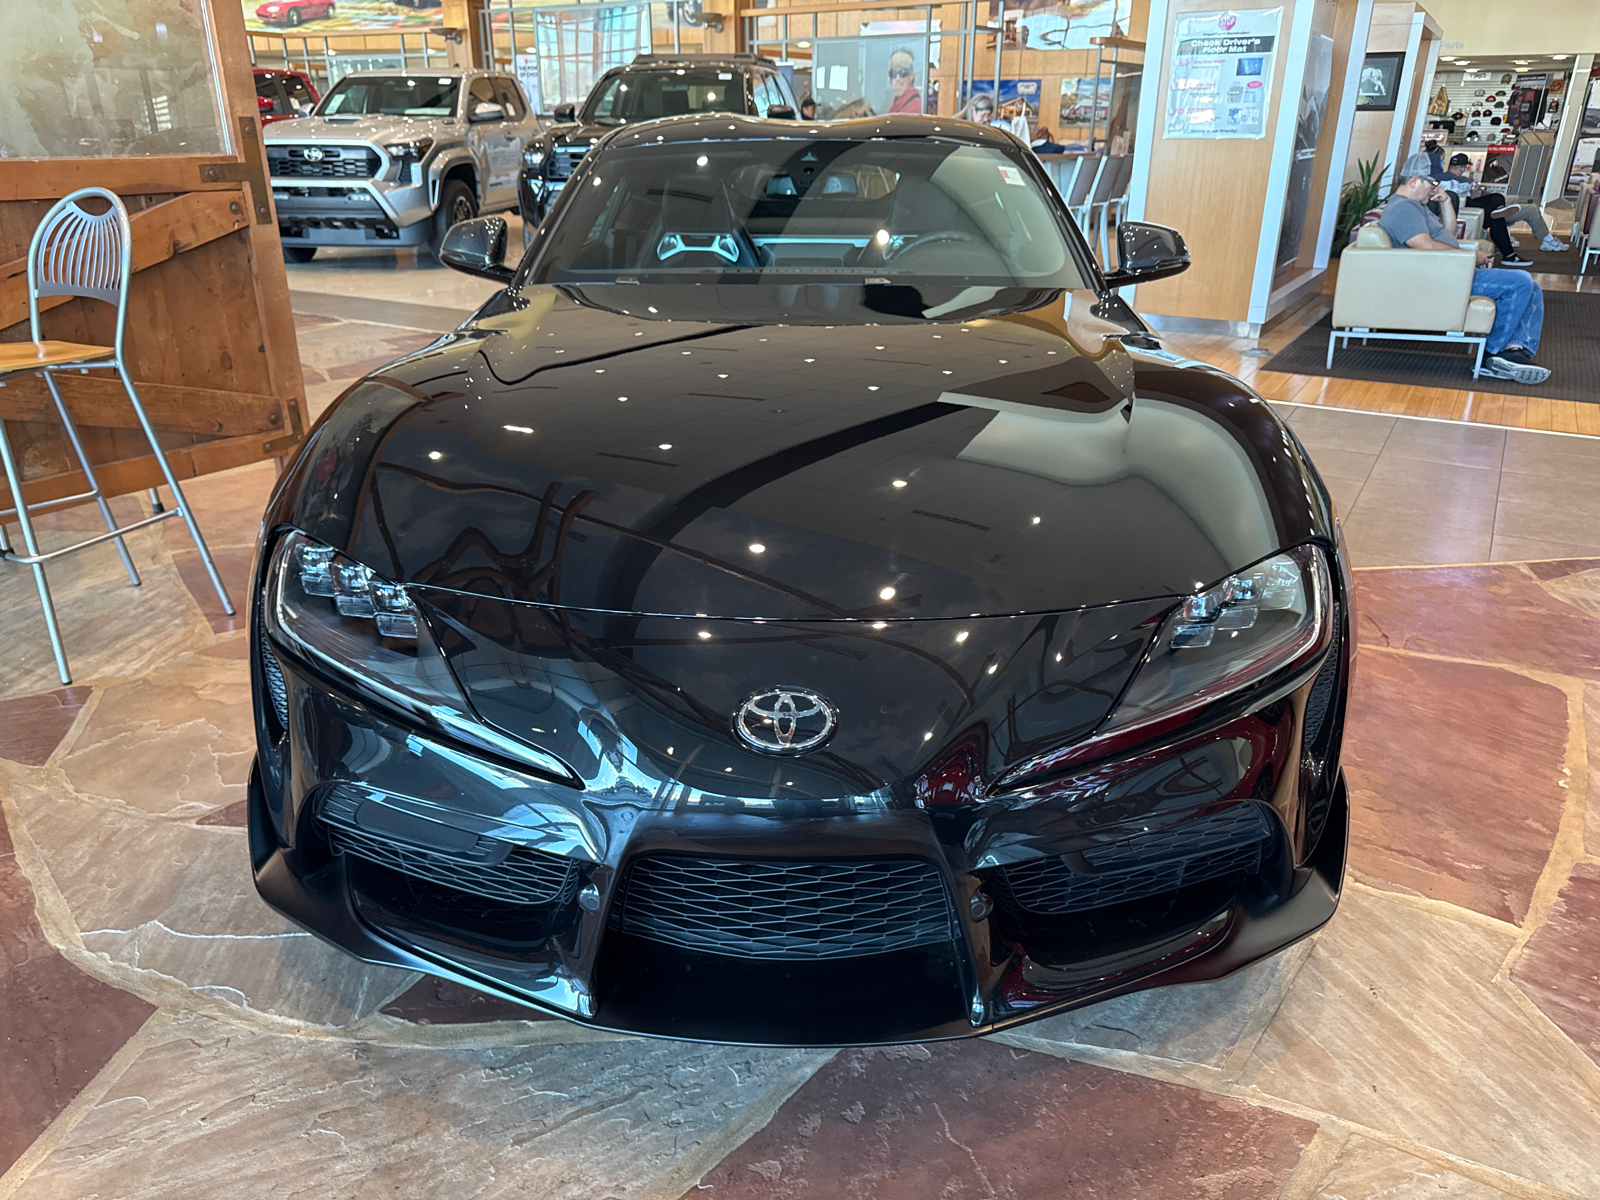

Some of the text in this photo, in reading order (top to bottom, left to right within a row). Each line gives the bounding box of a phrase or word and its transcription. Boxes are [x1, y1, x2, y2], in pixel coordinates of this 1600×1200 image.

[1220, 15, 1236, 26] STOP
[1191, 37, 1261, 47] Check Driver's
[1440, 41, 1464, 49] Parts
[1202, 45, 1248, 54] Floor Mat
